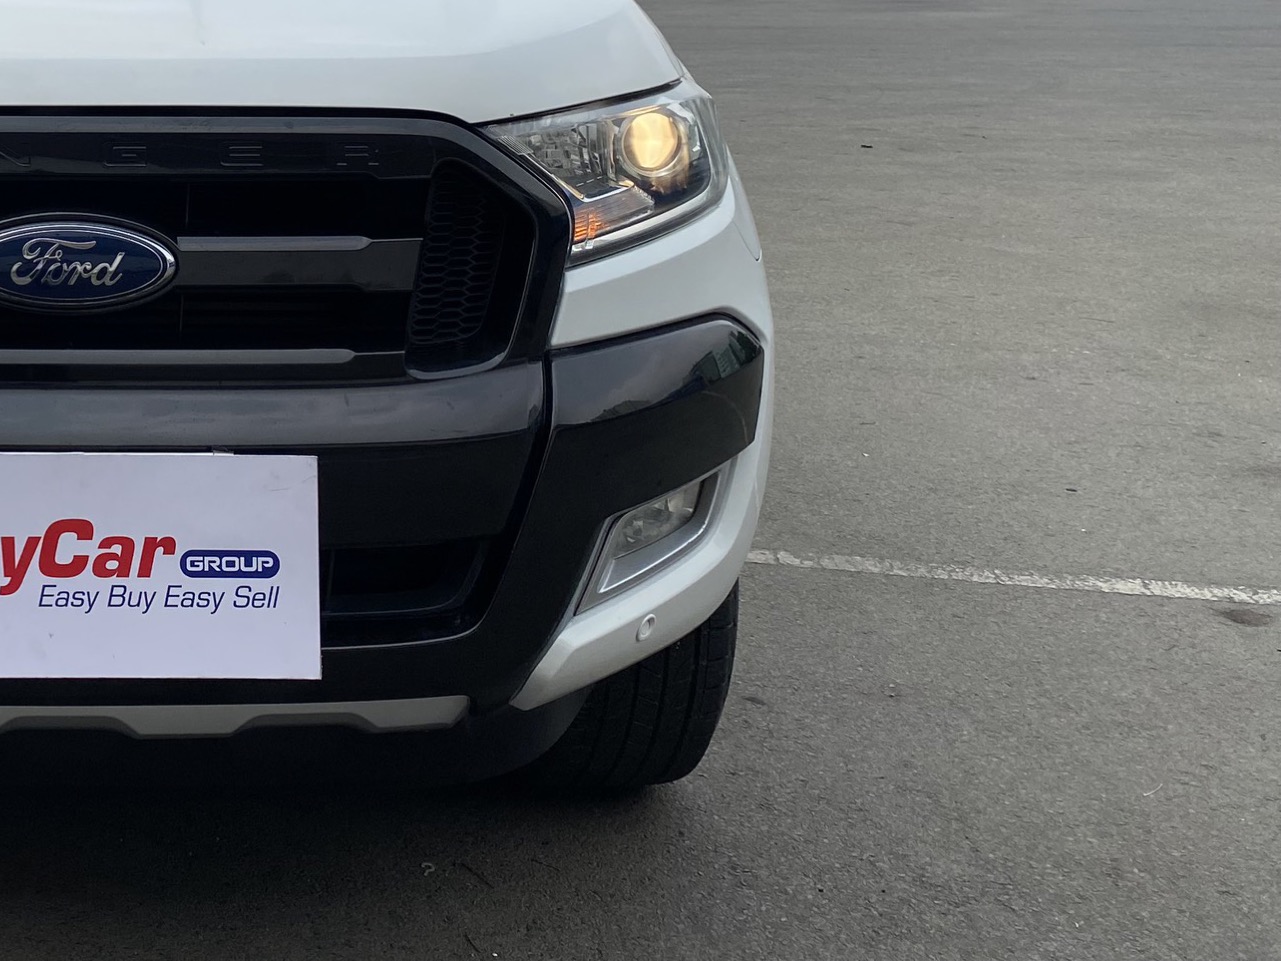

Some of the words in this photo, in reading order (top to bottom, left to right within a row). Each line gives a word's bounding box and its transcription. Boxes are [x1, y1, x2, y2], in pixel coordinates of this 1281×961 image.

[9, 238, 125, 288] Ford
[185, 556, 274, 573] GROUP
[38, 585, 99, 614] Easy
[106, 585, 157, 614] Buy
[163, 585, 225, 614] Easy
[232, 585, 280, 610] Sell
